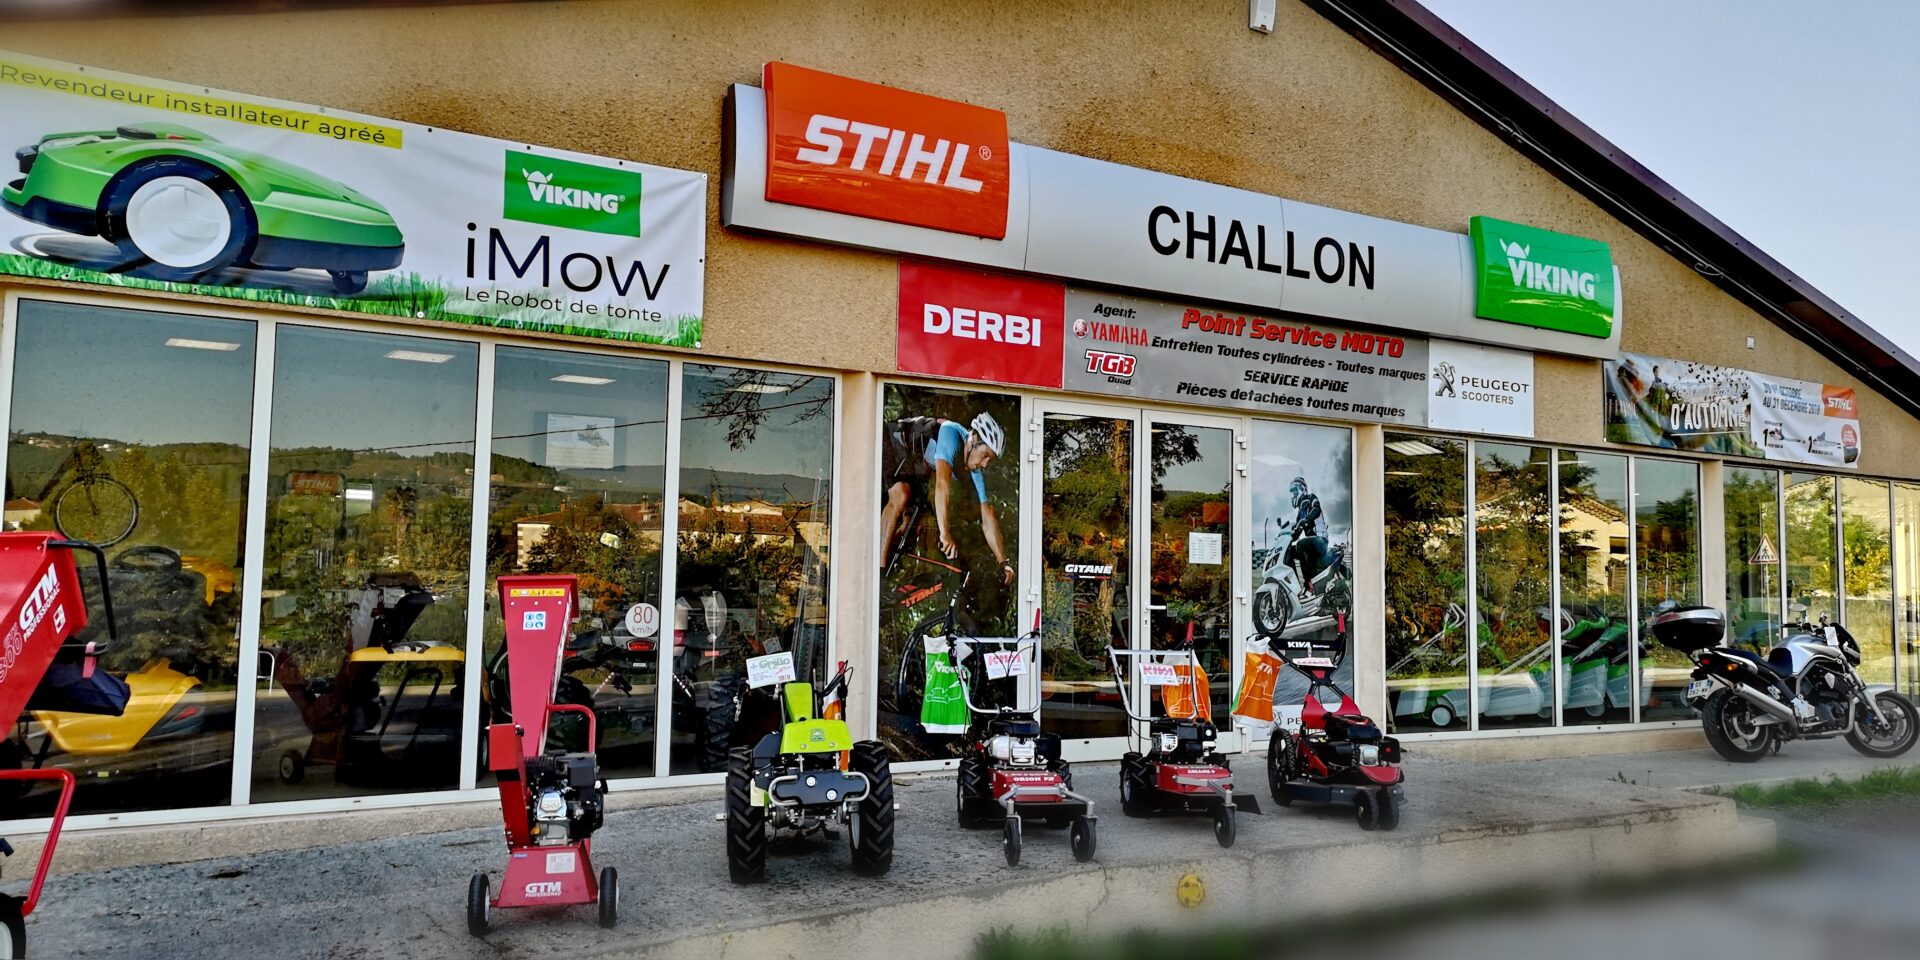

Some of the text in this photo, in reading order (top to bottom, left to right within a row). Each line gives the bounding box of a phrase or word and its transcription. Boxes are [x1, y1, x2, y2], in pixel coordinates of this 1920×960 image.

[1, 64, 386, 144] Revendeur installateur agréé
[796, 113, 984, 193] STIHL
[527, 181, 620, 214] VIKING
[466, 222, 671, 301] iMow
[1148, 205, 1375, 290] CHALLON
[1507, 257, 1595, 300] VIKING
[465, 286, 662, 323] Le Robot de tonte
[1093, 303, 1136, 319] Agent:
[924, 303, 1042, 347] DERBI
[1090, 321, 1148, 347] YAMAHA
[1181, 308, 1405, 358] Point Service MOTO
[1086, 350, 1136, 377] TGB
[1152, 336, 1213, 355] Entretien
[1217, 344, 1260, 361] Toutes
[1262, 351, 1325, 369] cylindrées
[1336, 360, 1375, 375] Toutes
[1379, 367, 1426, 382] marques
[1108, 376, 1131, 385] Quad
[1461, 376, 1530, 394] PEUGEOT
[1177, 382, 1227, 399] Pièces
[1306, 396, 1349, 412] toutes
[1352, 403, 1405, 418] marques
[1461, 390, 1514, 405] SCOOTERS
[1827, 397, 1852, 411] STIHL
[1065, 564, 1113, 575] GITANE
[20, 562, 58, 631] GTM
[632, 625, 653, 634] km/h
[633, 606, 652, 623] 80
[525, 881, 562, 894] GTM
